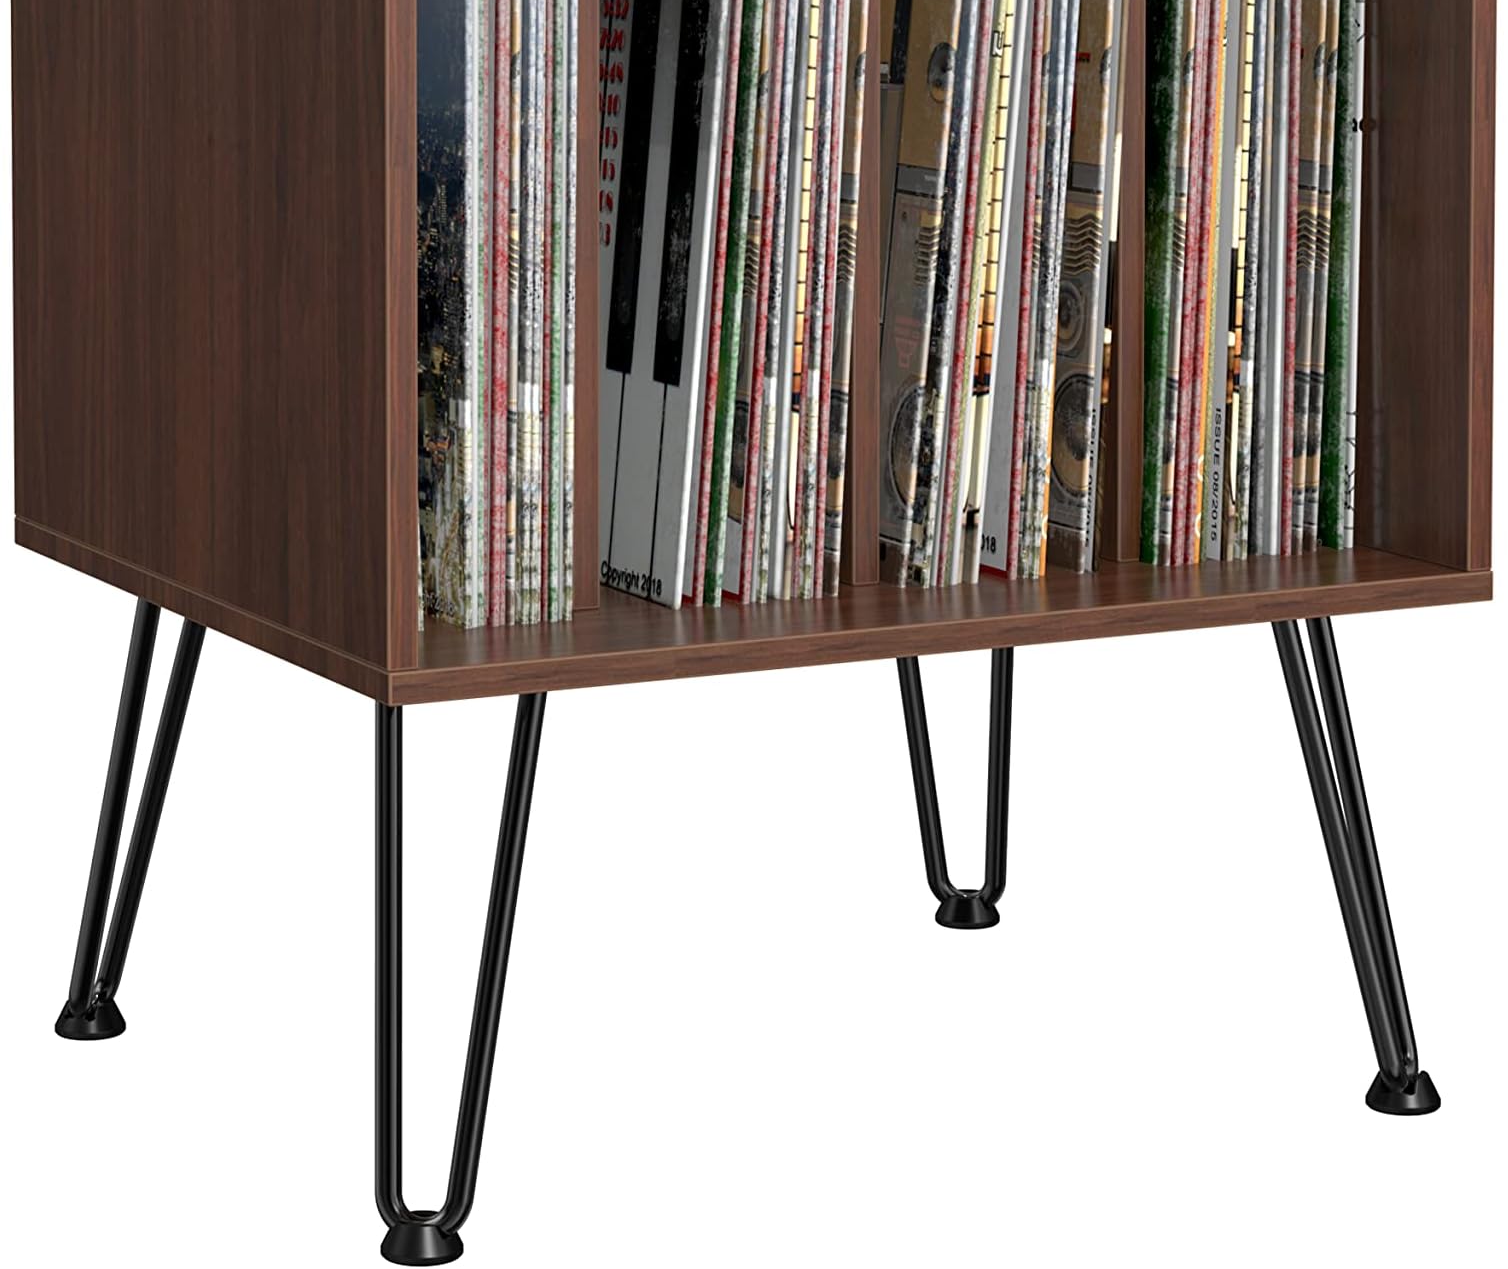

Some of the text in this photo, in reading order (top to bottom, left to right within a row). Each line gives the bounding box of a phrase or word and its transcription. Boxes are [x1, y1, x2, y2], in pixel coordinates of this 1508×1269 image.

[1213, 408, 1221, 466] ISSUE
[601, 560, 662, 597] Copyright 2018
